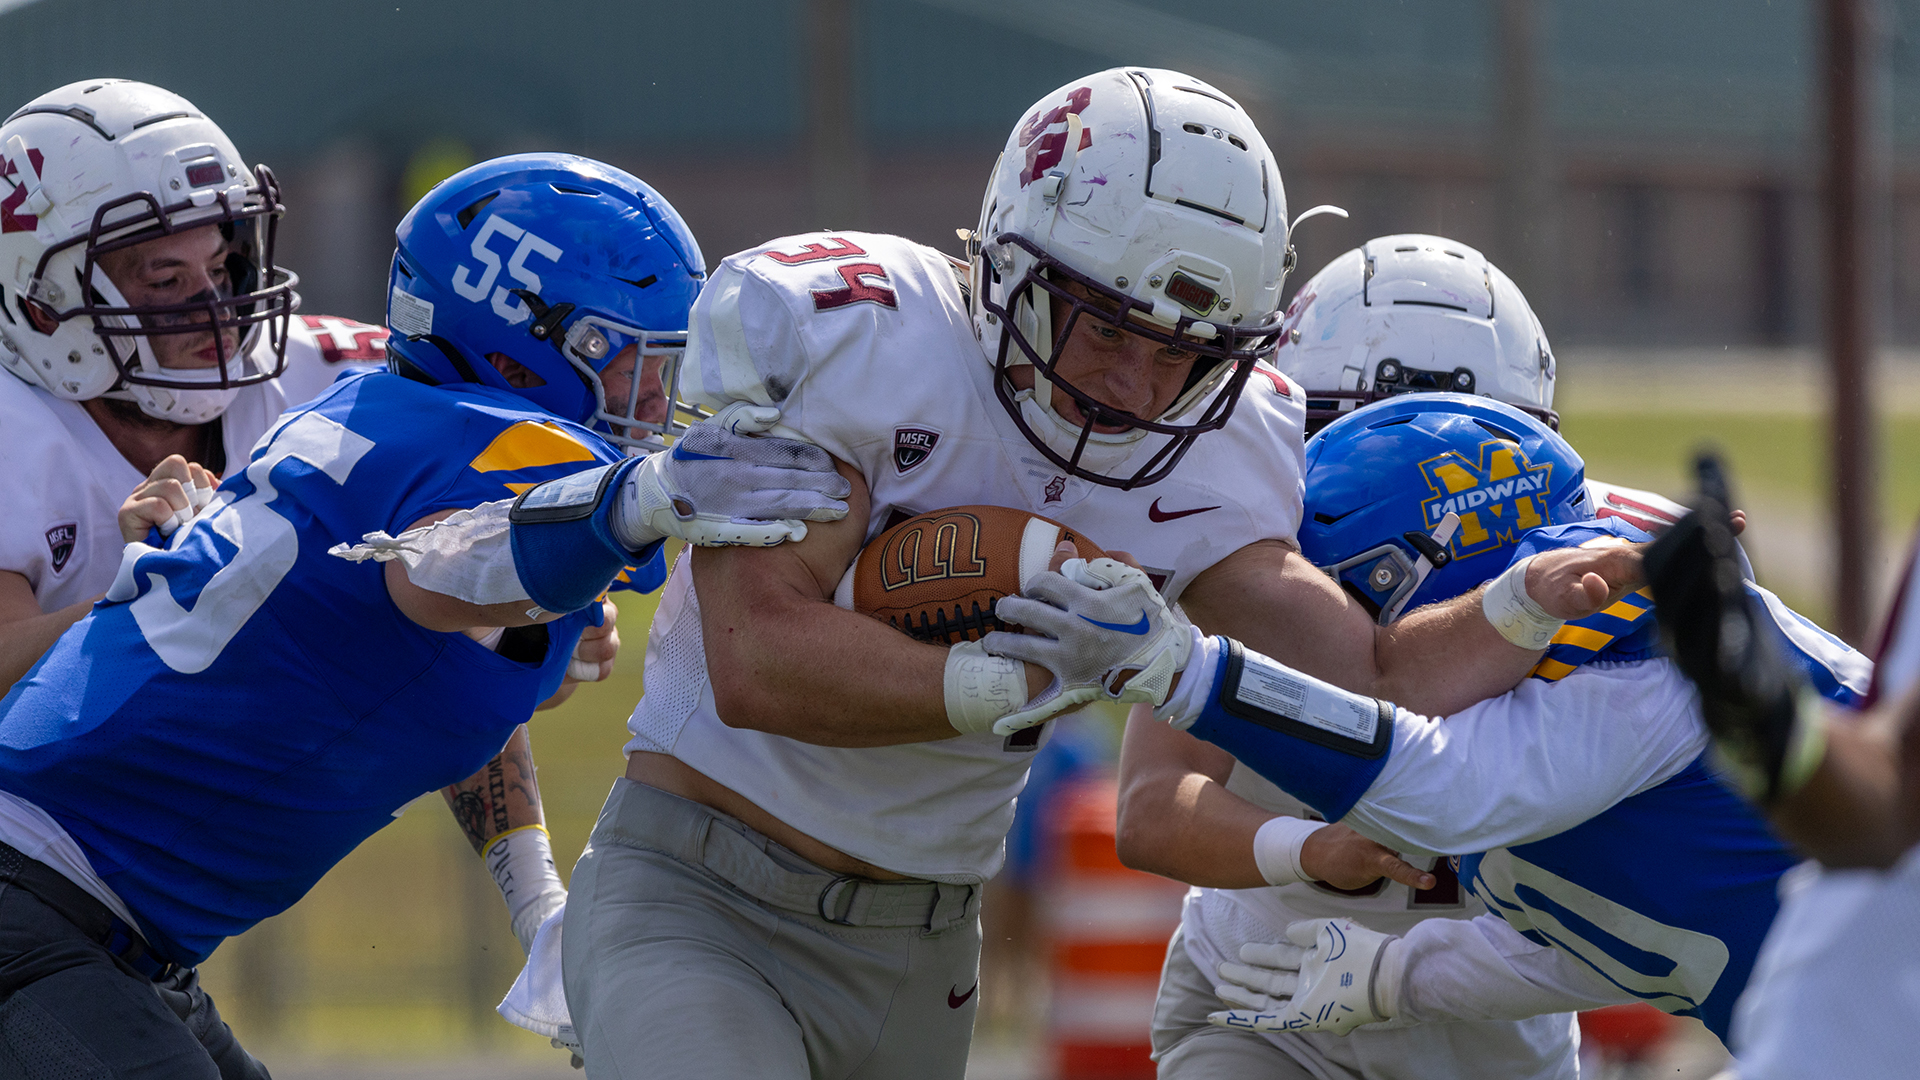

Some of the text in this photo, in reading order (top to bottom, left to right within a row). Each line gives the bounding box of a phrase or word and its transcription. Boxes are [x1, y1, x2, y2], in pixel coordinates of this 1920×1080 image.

[452, 213, 563, 326] 55
[757, 237, 900, 313] 34
[1168, 278, 1214, 309] KNIGHTS
[899, 432, 931, 447] MSFL
[1431, 473, 1545, 520] MIDWAY
[48, 527, 74, 547] MSFL
